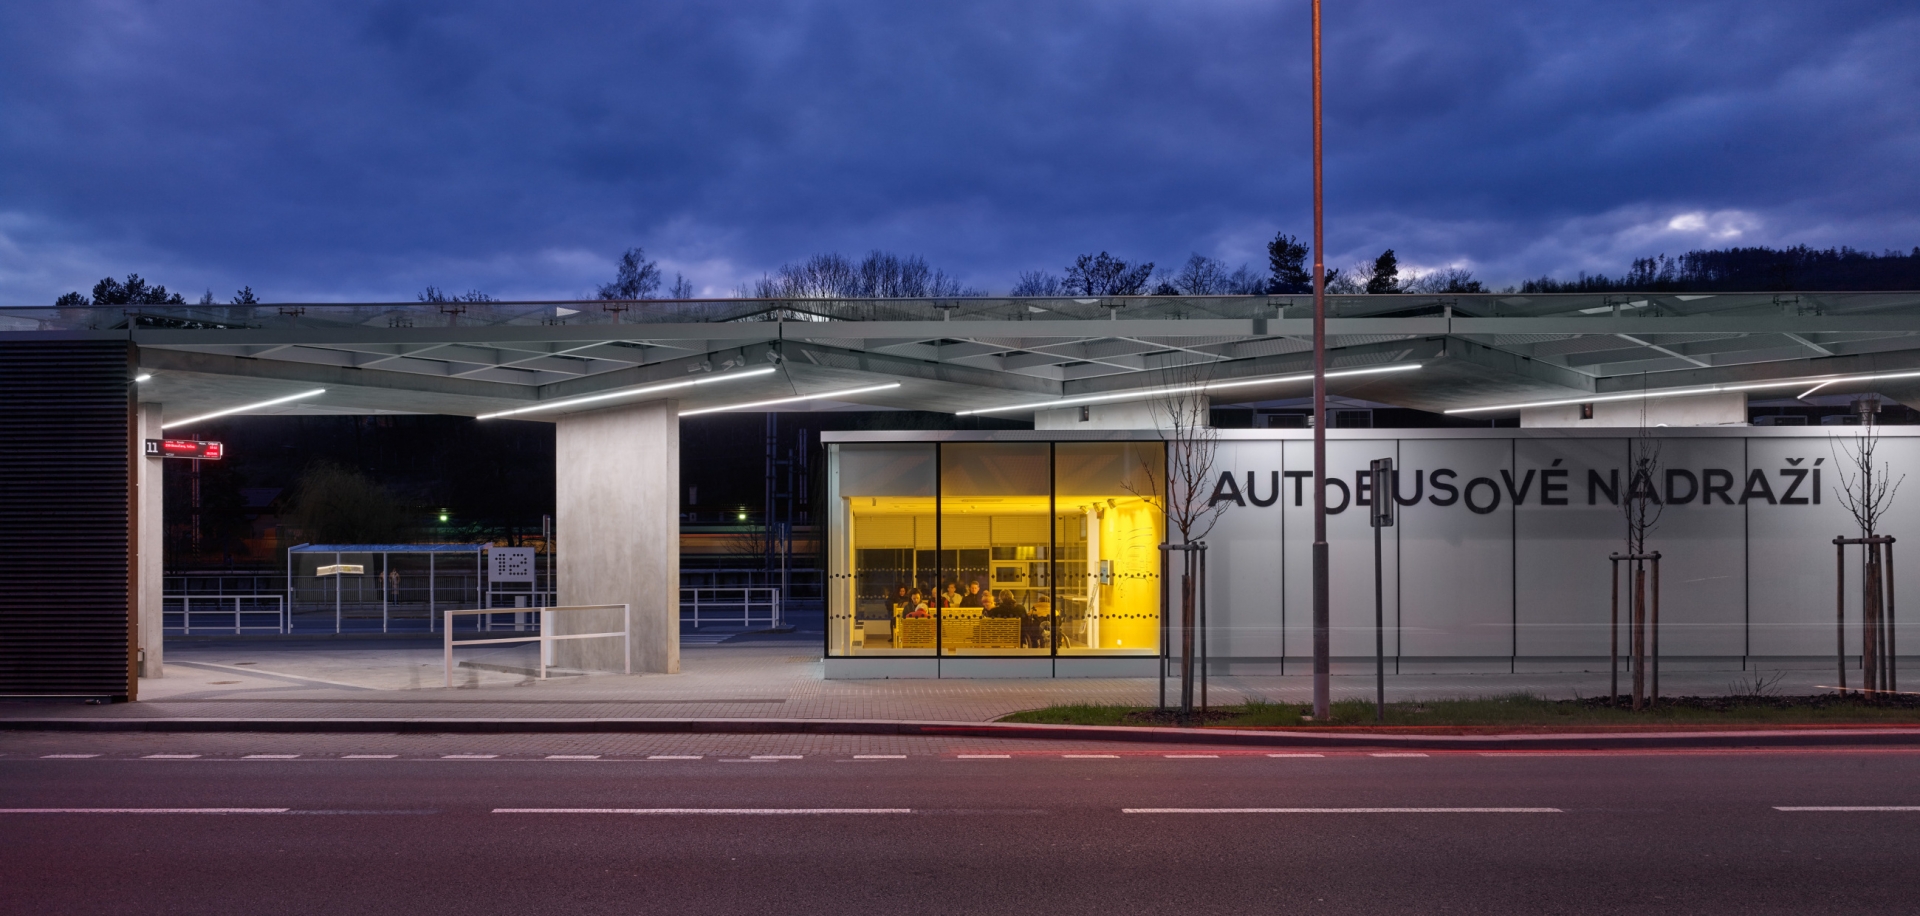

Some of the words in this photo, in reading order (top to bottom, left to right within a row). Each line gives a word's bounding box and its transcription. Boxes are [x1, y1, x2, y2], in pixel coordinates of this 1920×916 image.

[147, 442, 158, 453] 11
[1588, 457, 1826, 505] NÁDRAŽÍ
[495, 553, 527, 575] 12
